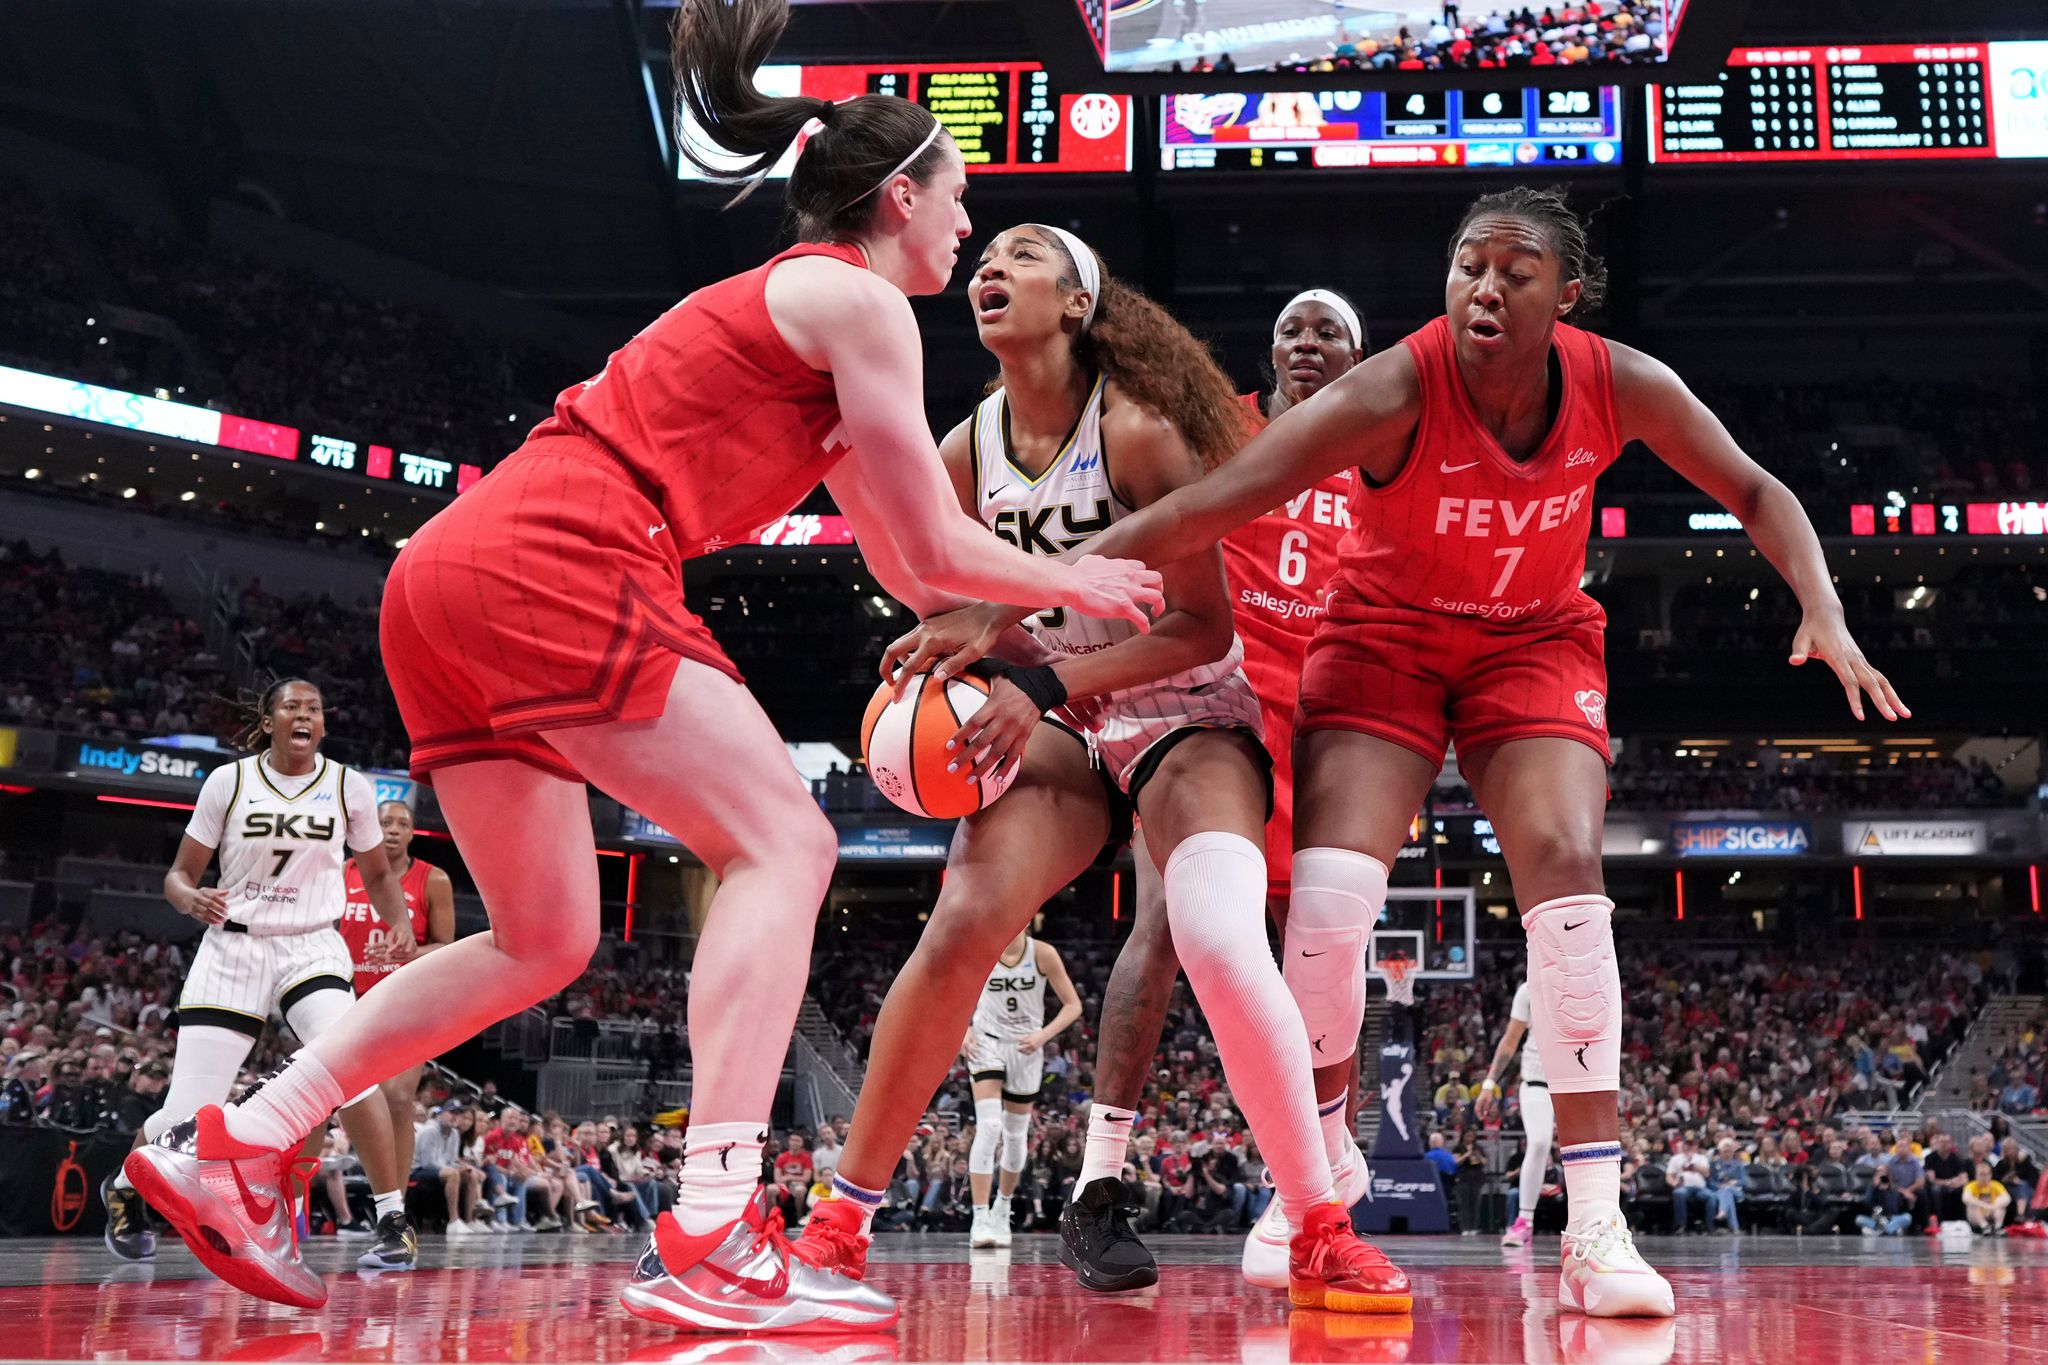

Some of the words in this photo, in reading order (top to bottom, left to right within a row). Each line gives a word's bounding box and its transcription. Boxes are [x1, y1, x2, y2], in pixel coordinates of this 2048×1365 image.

[1406, 94, 1425, 115] 4
[1483, 93, 1502, 114] 6
[310, 445, 355, 470] 4/13
[1565, 448, 1598, 468] Lilly
[1266, 488, 1353, 530] VER
[1435, 485, 1588, 538] FEVER
[1689, 513, 1743, 530] CHICA
[1278, 530, 1309, 586] 6
[1490, 547, 1526, 598] 7
[241, 812, 335, 841] SKY
[1673, 826, 1809, 850] SHIPSIGMA
[270, 848, 295, 877] 7
[988, 976, 1036, 992] SKY
[1006, 997, 1018, 1012] 9
